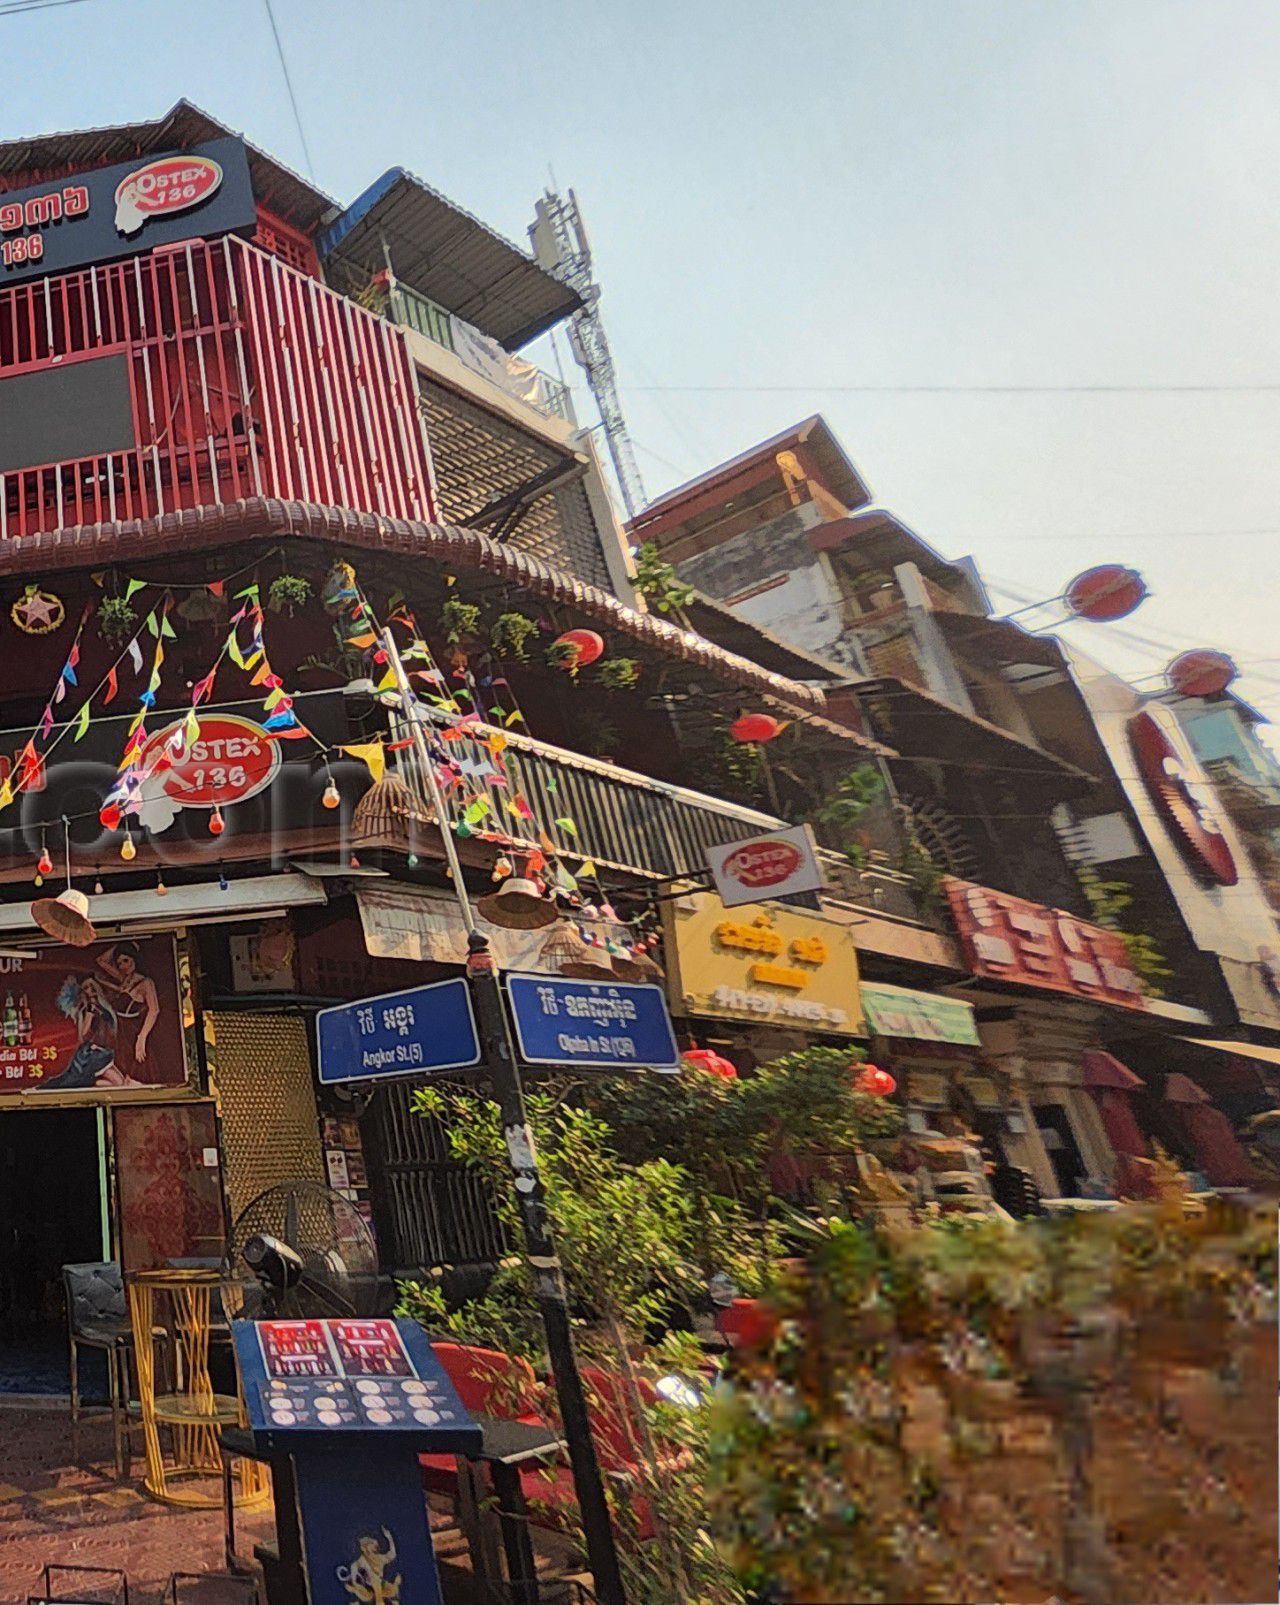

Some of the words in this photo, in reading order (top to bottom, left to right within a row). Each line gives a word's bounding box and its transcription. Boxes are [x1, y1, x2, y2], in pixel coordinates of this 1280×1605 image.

[137, 165, 207, 194] OSTEX
[158, 184, 196, 204] 136
[0, 185, 89, 232] ១៣៦
[1, 233, 43, 265] 136
[164, 736, 261, 767] OSTEX
[193, 766, 247, 791] 136
[356, 1006, 376, 1035] វិថី
[382, 1004, 415, 1036] អង្គរ
[42, 1046, 58, 1060] 3$
[363, 1047, 396, 1069] Angkor
[28, 1063, 44, 1078] 3$
